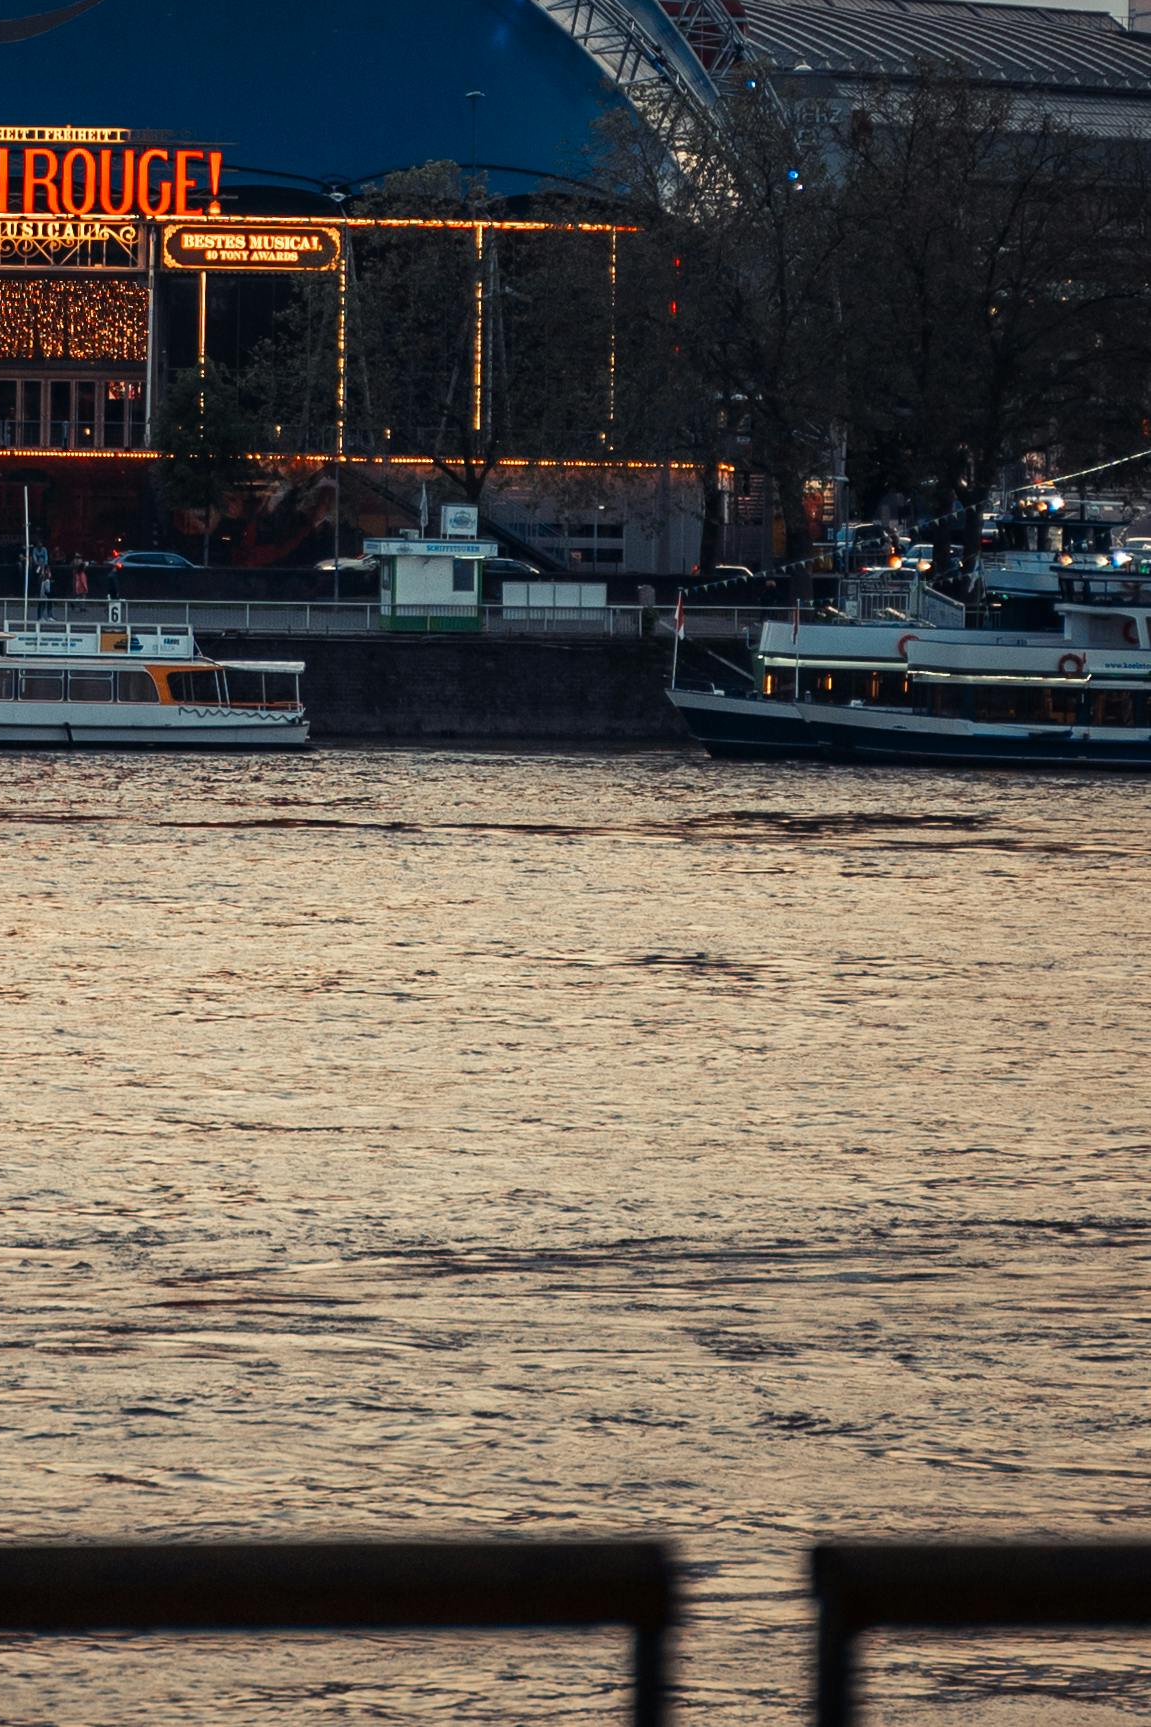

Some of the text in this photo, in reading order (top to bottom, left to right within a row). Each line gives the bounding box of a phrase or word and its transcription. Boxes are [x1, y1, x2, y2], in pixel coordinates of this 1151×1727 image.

[45, 128, 112, 142] FREIHEIT
[22, 147, 223, 215] ROUGE!
[182, 233, 323, 251] BESTES MUSICAL
[206, 250, 298, 262] 10 TONY AWARDS
[110, 606, 119, 623] 6
